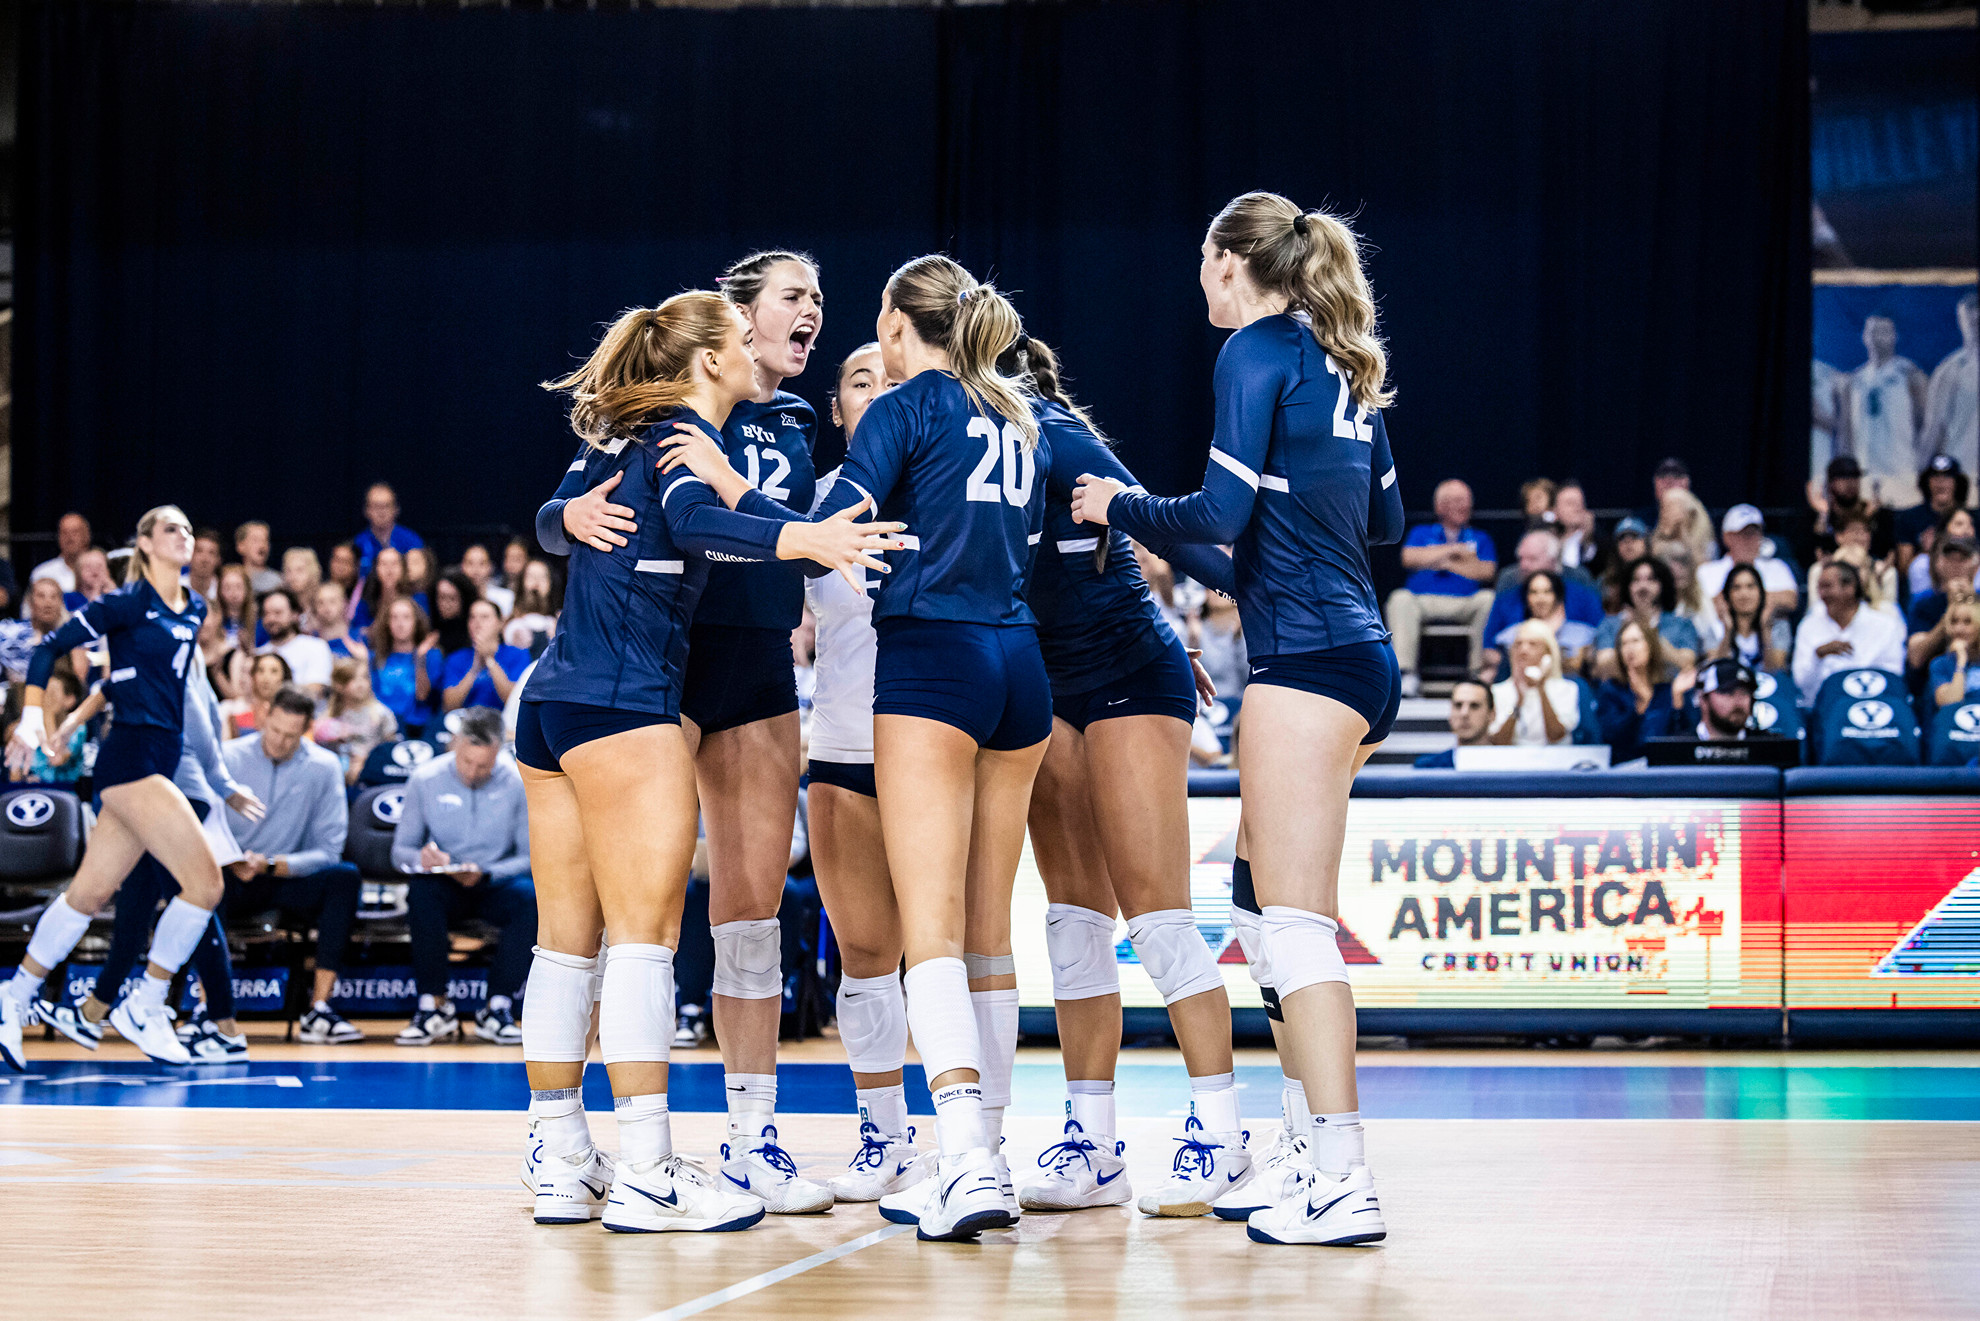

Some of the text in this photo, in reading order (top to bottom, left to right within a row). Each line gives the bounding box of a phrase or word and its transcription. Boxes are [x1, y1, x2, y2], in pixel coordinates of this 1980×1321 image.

[741, 424, 776, 443] BYU
[743, 444, 791, 501] 12
[966, 416, 1035, 508] 20
[172, 642, 190, 679] 4
[1371, 823, 1698, 882] MOUNTAIN
[1389, 880, 1675, 940] AMERICA
[1422, 952, 1644, 972] CREDIT UNION
[939, 1089, 963, 1100] NIKE
